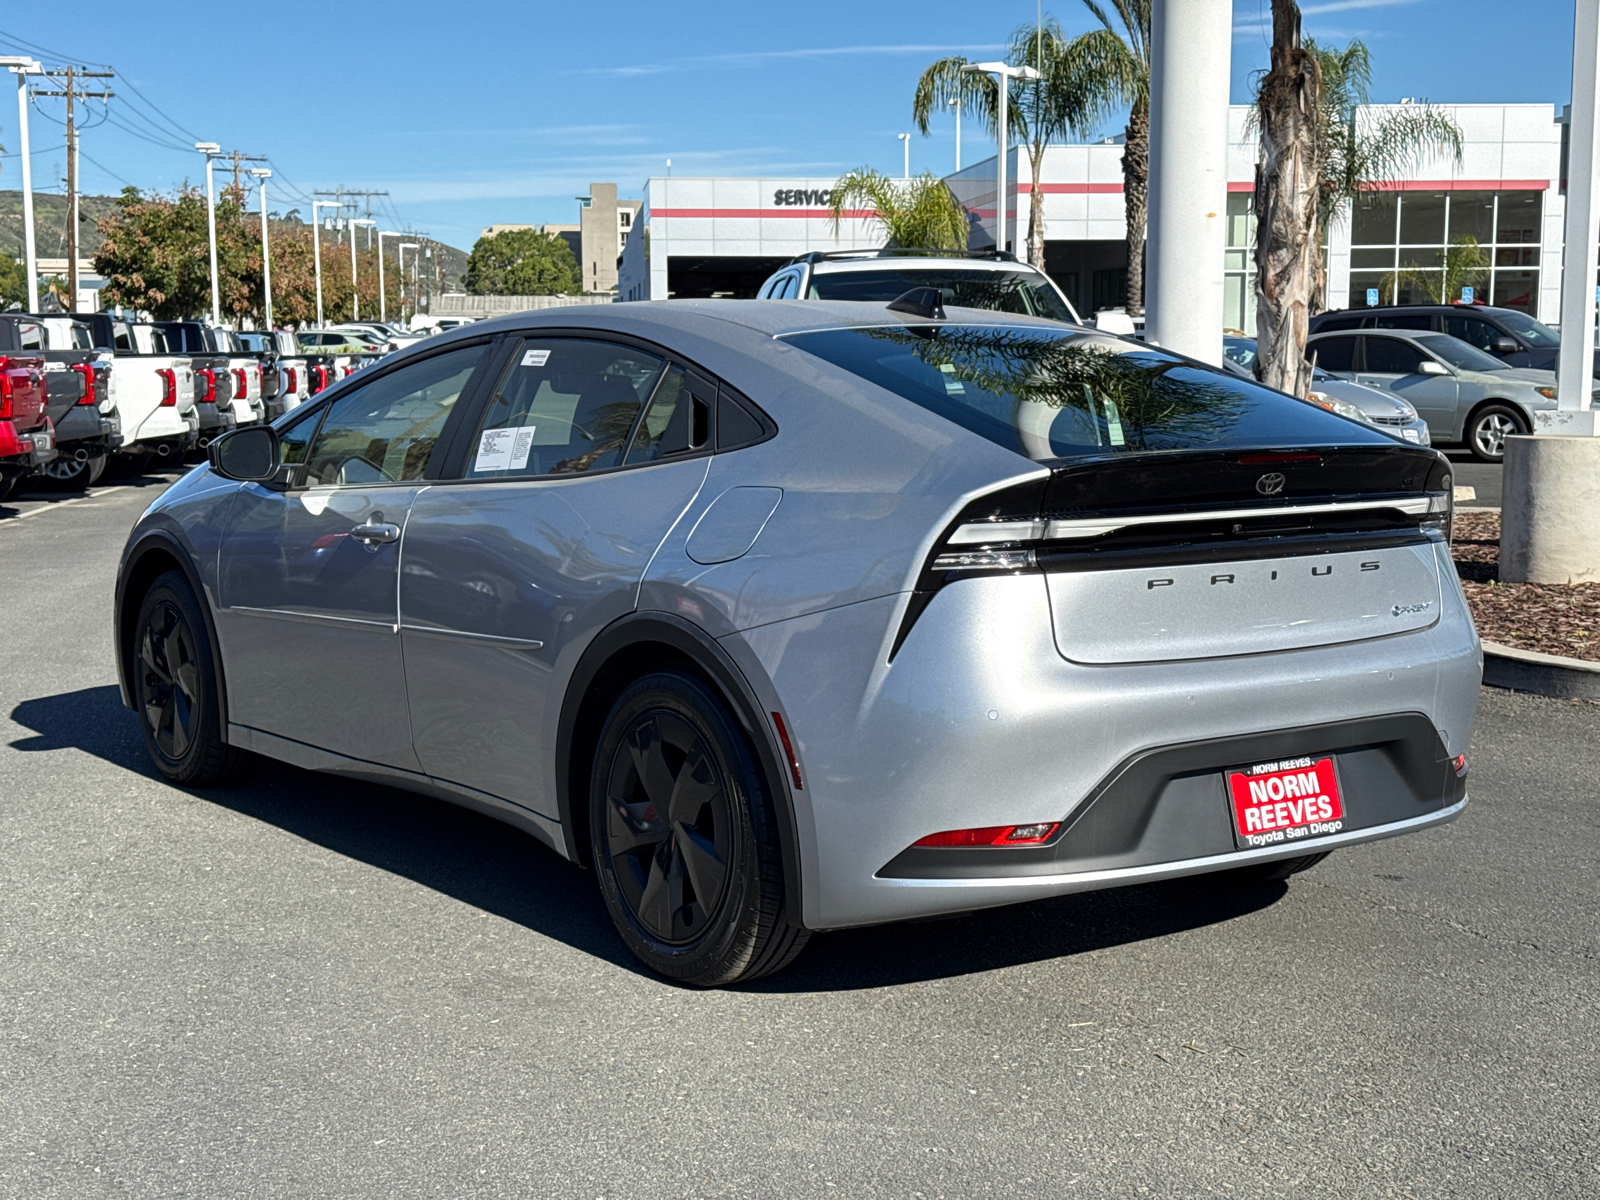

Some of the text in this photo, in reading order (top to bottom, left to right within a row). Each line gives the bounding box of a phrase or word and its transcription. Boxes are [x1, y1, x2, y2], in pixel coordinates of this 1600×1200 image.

[1147, 561, 1380, 590] PRIUS
[1252, 757, 1311, 775] NORM REEVES
[1248, 771, 1320, 804] NORM
[1244, 795, 1333, 832] REEVES
[1245, 821, 1343, 846] Toyota San Diego
